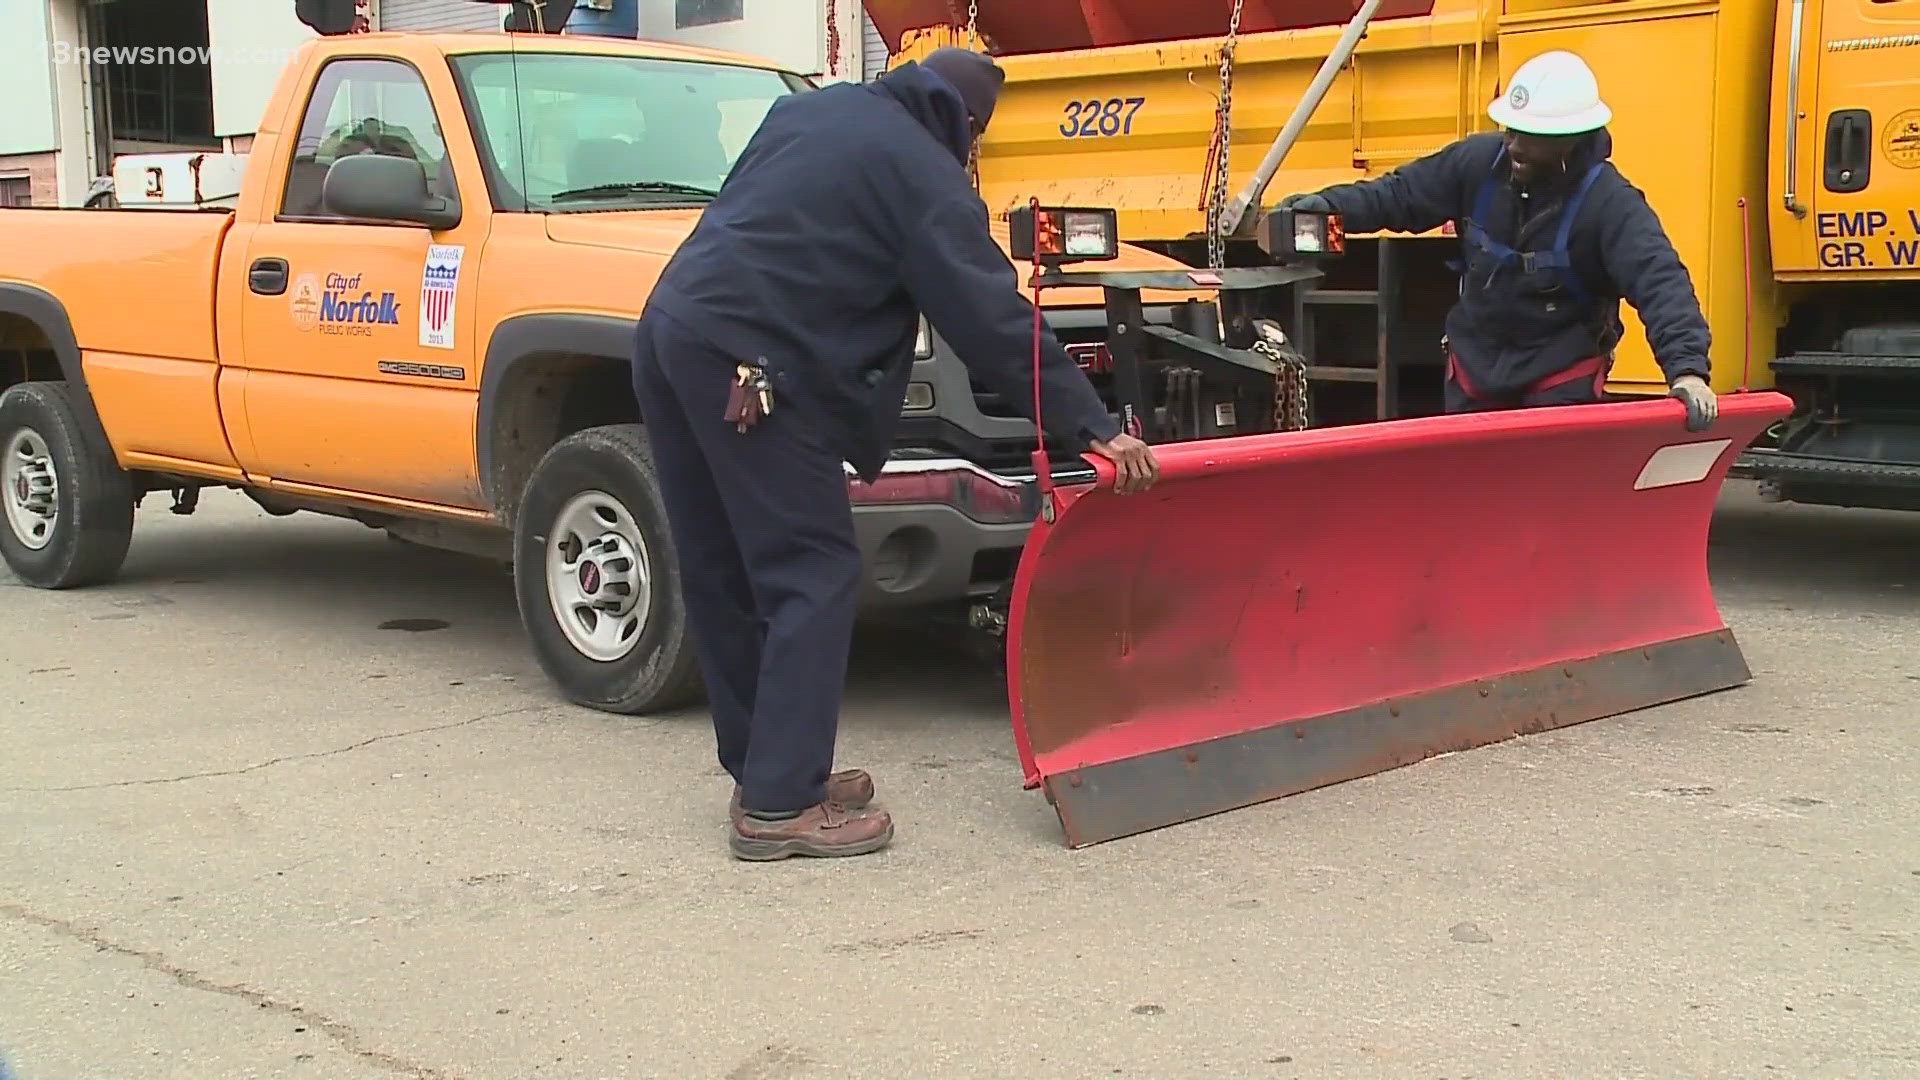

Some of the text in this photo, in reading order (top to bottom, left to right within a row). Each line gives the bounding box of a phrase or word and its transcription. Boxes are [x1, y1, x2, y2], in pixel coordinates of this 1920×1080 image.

[1060, 97, 1145, 137] 3287
[1818, 211, 1895, 238] EMP.
[429, 247, 460, 260] Norfolk
[1820, 242, 1873, 267] GR.
[326, 272, 361, 294] City of
[319, 291, 401, 324] Norfolk
[319, 324, 371, 336] PUBLIC WORKS
[428, 334, 444, 344] 2013
